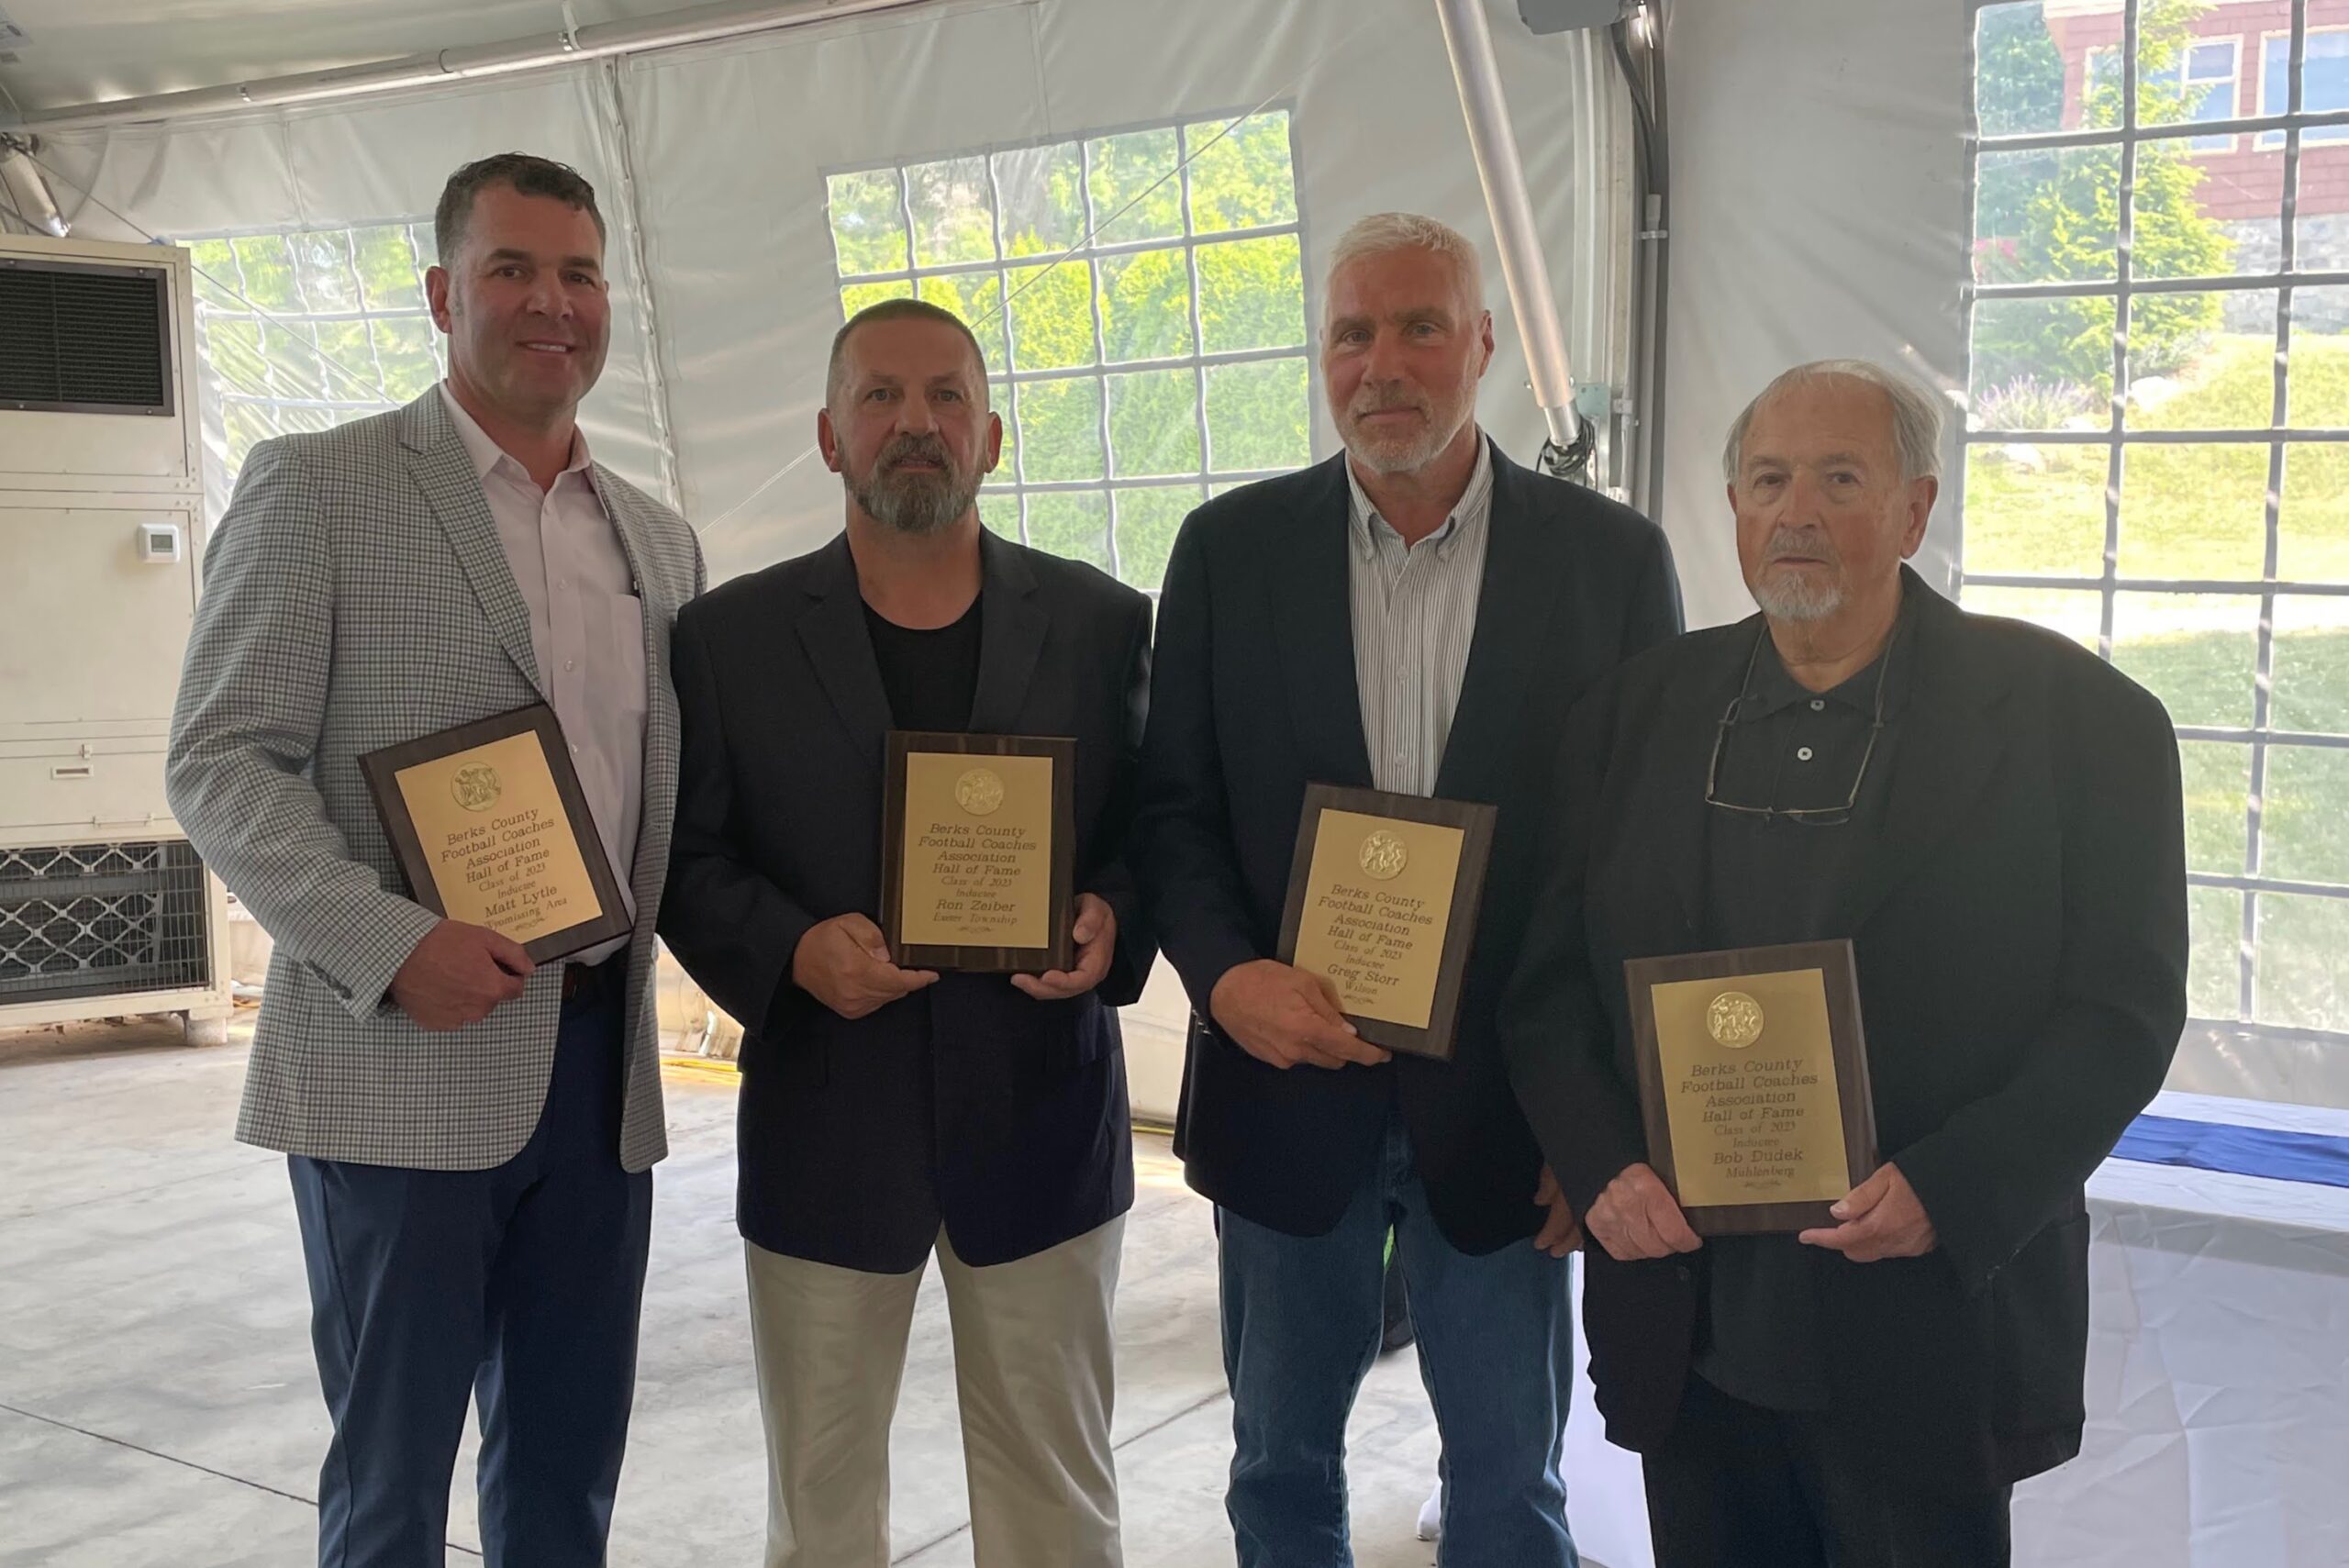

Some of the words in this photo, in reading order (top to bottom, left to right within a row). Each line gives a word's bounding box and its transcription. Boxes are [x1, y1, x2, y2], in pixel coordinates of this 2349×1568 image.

[448, 828, 486, 845] Berks
[492, 808, 539, 830] County
[930, 823, 969, 835] Berks
[976, 826, 1026, 838] County
[440, 836, 496, 862] Football
[502, 818, 554, 842] Coaches
[918, 836, 975, 849] Football
[982, 839, 1036, 850] Coaches
[466, 839, 540, 869] Association
[938, 851, 1016, 863] Association
[466, 869, 492, 884] Hall
[497, 859, 508, 873] of
[515, 850, 550, 868] Fame
[932, 863, 961, 873] Hall
[966, 864, 980, 874] of
[985, 865, 1021, 875] Fame
[479, 878, 504, 892] Class
[509, 872, 518, 882] of
[941, 875, 967, 885] Class
[974, 877, 985, 886] of
[485, 897, 518, 917] Matt
[523, 885, 558, 906] Lytle
[936, 899, 963, 910] Ron
[970, 900, 1016, 912] Zeiber
[1331, 884, 1370, 899] Berks
[1375, 892, 1424, 911] County
[1318, 896, 1374, 915] Football
[1379, 906, 1432, 925] Coaches
[1334, 914, 1410, 936] Association
[1328, 926, 1354, 940] Hall
[1359, 932, 1373, 942] of
[1376, 934, 1413, 950] Fame
[1334, 940, 1358, 953] Class
[1364, 946, 1375, 955] of
[1328, 963, 1361, 981] Greg
[1365, 972, 1399, 986] Storr
[1344, 980, 1377, 995] Wilson
[1691, 1063, 1736, 1077] Berks
[1744, 1058, 1803, 1073] County
[1681, 1078, 1745, 1093] Football
[1753, 1073, 1819, 1087] Coaches
[1706, 1092, 1796, 1108] Association
[1703, 1109, 1731, 1123] Hall
[1739, 1108, 1755, 1119] of
[1761, 1106, 1804, 1119] Fame
[1714, 1124, 1743, 1136] Class
[1751, 1124, 1762, 1134] of
[1714, 1151, 1743, 1164] Bob
[1751, 1149, 1803, 1162] Dudek
